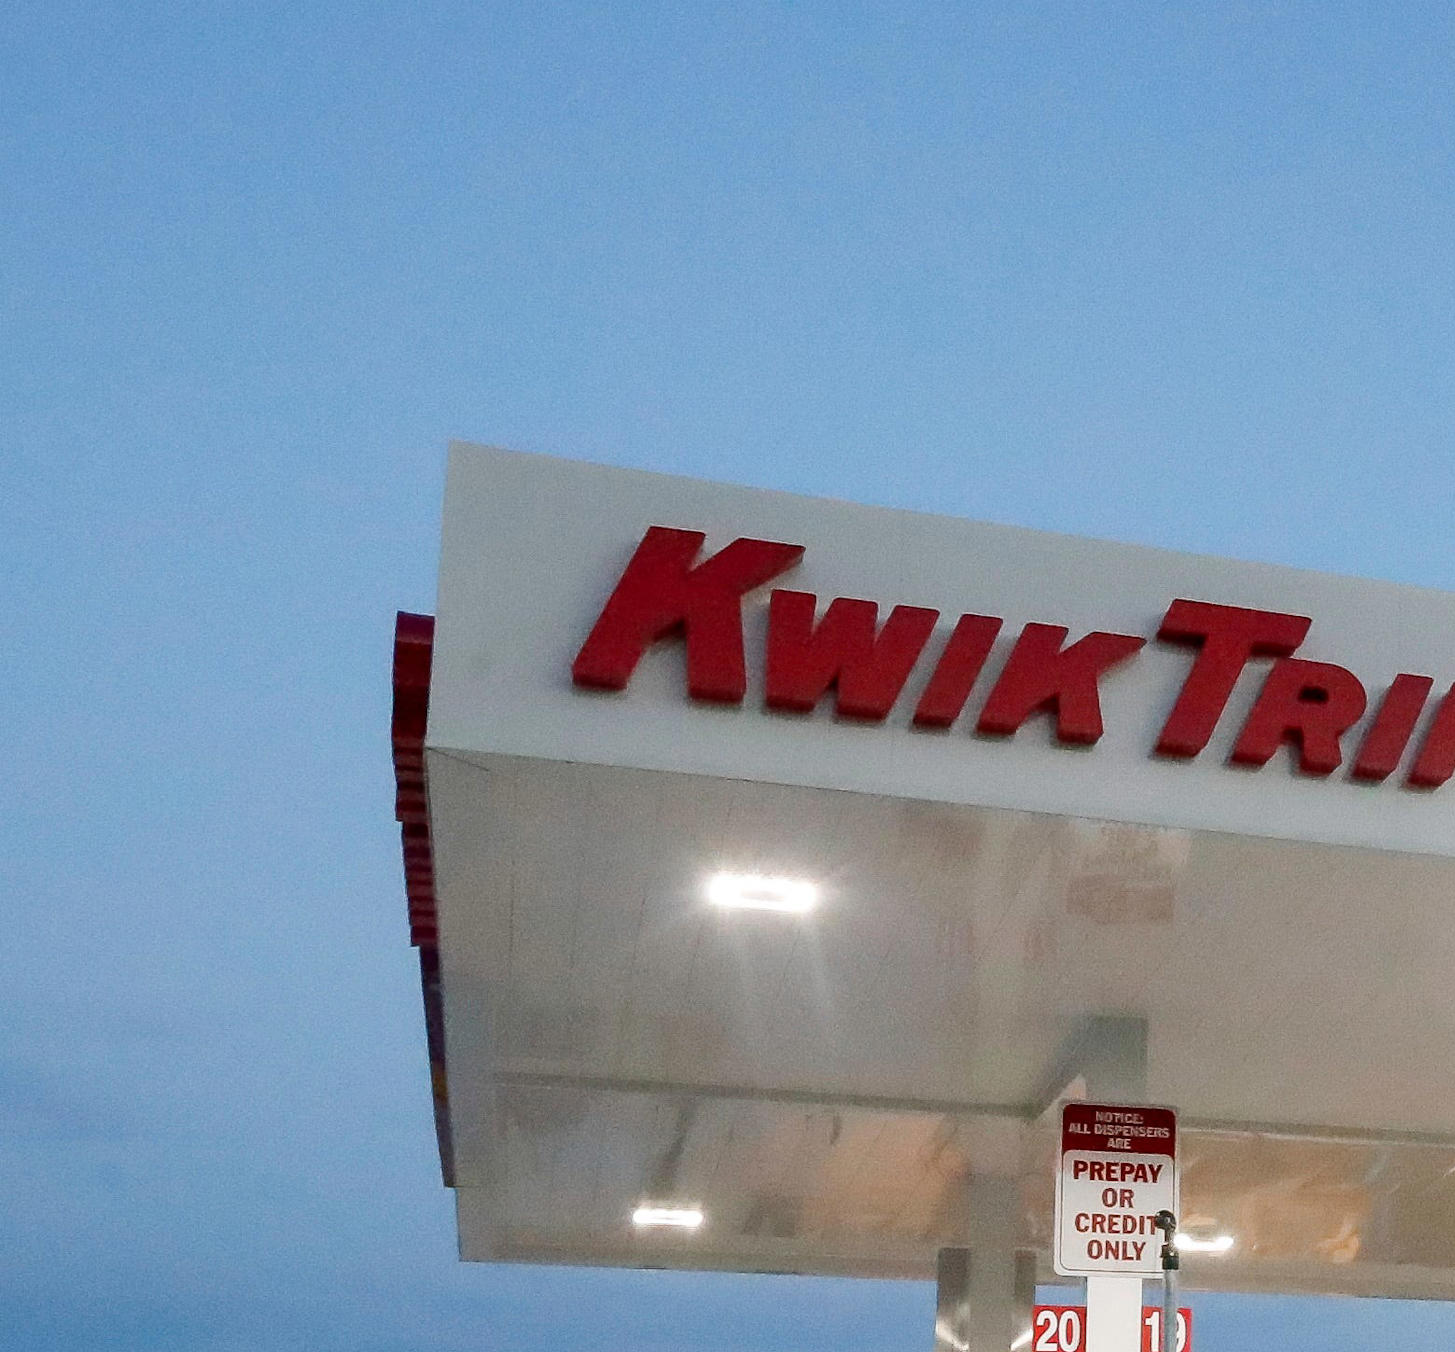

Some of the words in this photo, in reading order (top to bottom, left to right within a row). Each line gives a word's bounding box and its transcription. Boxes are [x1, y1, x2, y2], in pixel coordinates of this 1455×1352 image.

[571, 525, 1147, 747] KWIK
[1068, 1122, 1091, 1134] ALL
[1094, 1123, 1171, 1138] DISPENSERS
[1107, 1138, 1131, 1150] ARE
[1073, 1160, 1164, 1184] PREPAY
[1101, 1187, 1135, 1209] OR
[1074, 1212, 1159, 1236] CREDIT
[1087, 1239, 1147, 1261] ONLY
[1035, 1310, 1081, 1352] 20
